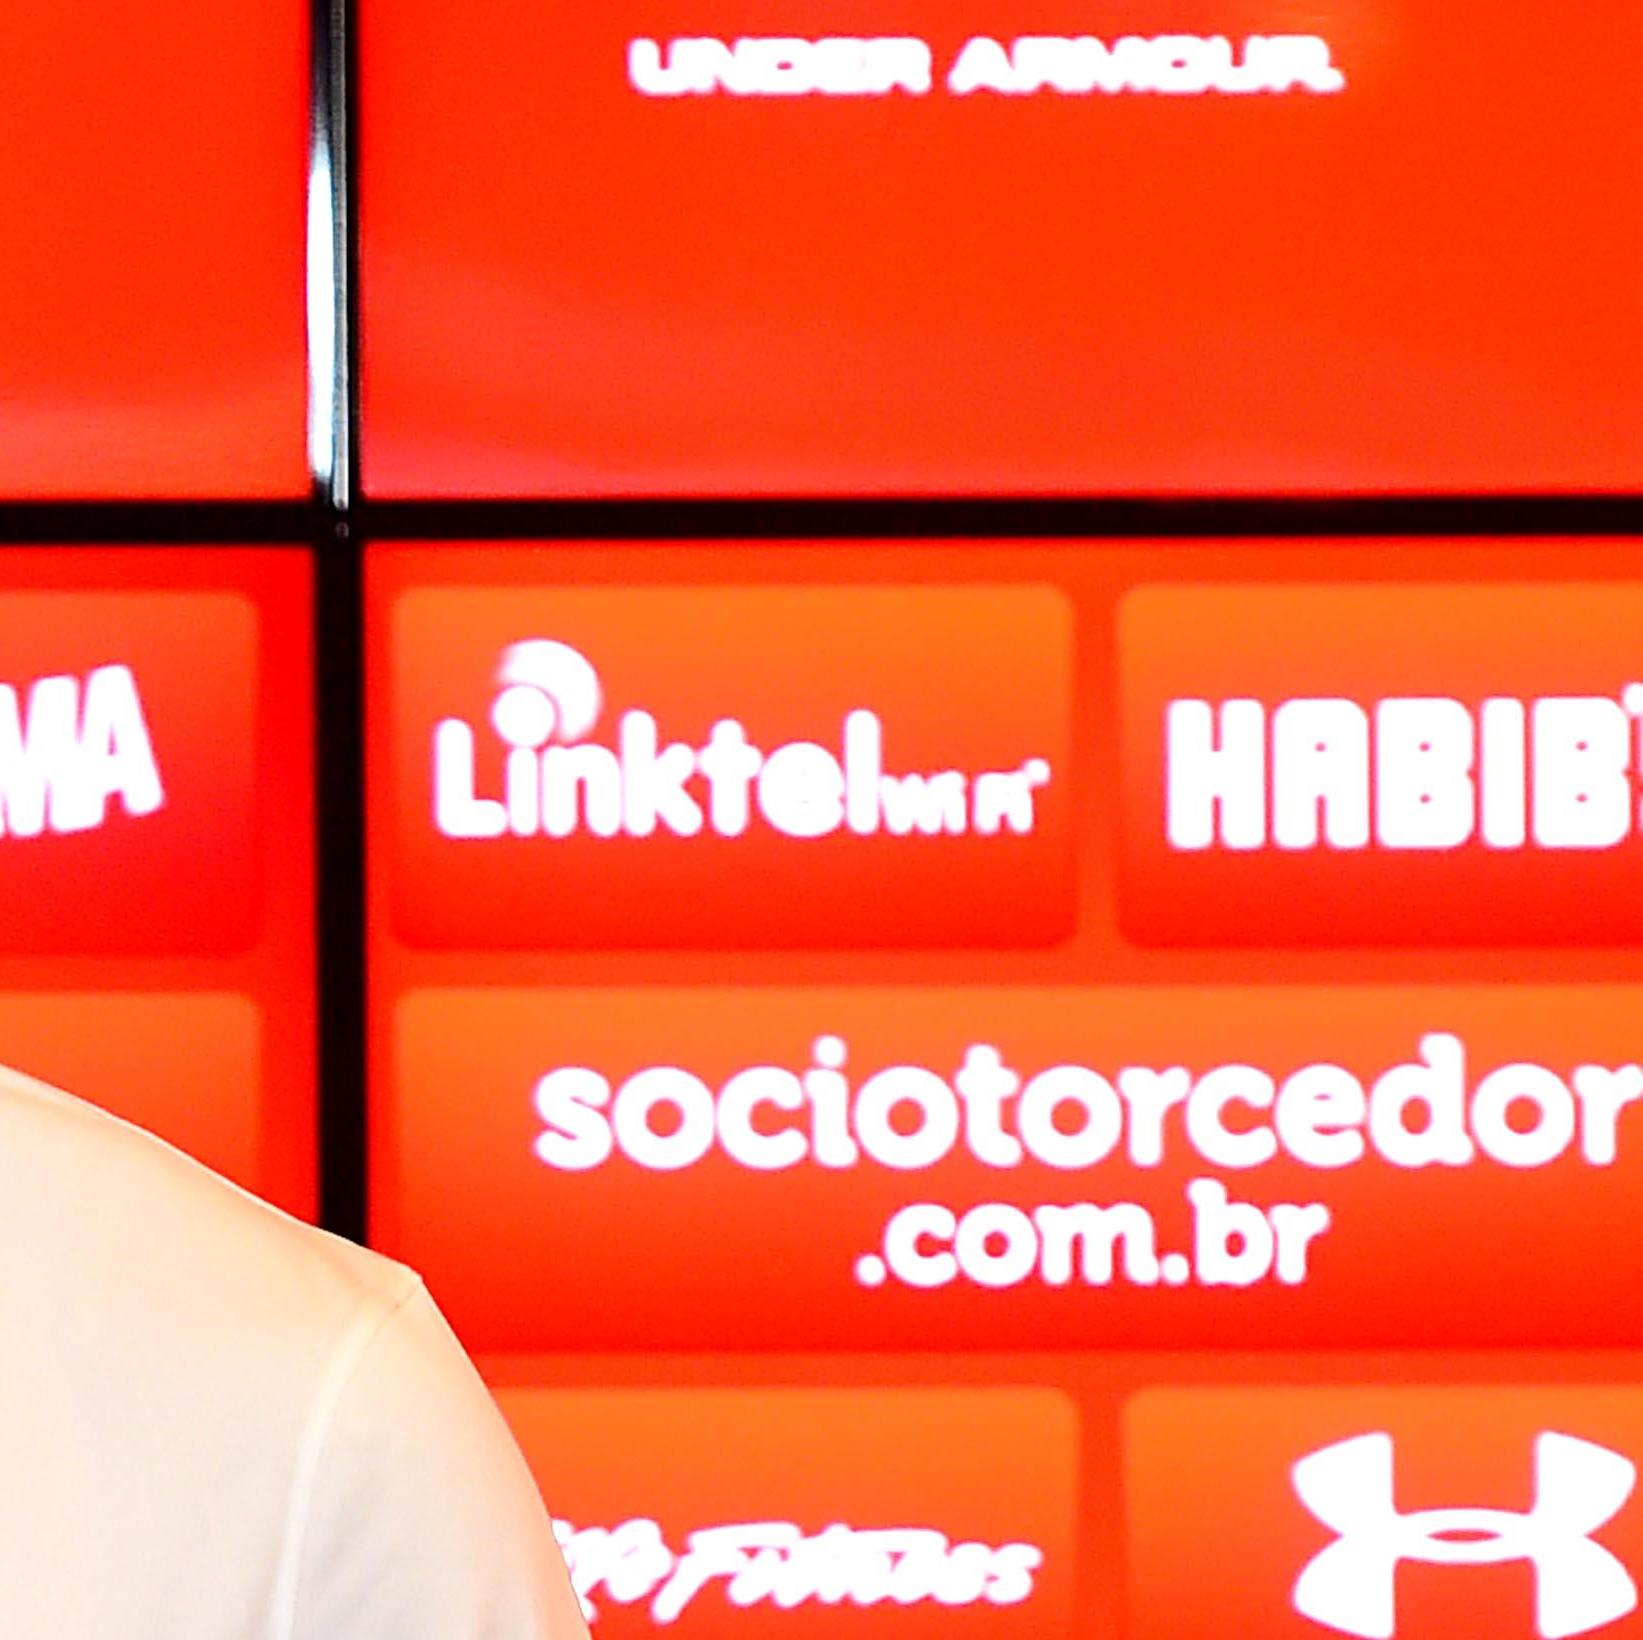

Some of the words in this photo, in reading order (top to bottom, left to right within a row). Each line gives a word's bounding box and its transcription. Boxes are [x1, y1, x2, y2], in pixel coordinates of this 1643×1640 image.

[630, 37, 931, 94] UNDER
[948, 35, 1345, 93] ARMOUR
[1167, 682, 1643, 849] HABIB'
[535, 1033, 1643, 1169] sociotorcedor
[857, 1178, 1330, 1286] .com.br
